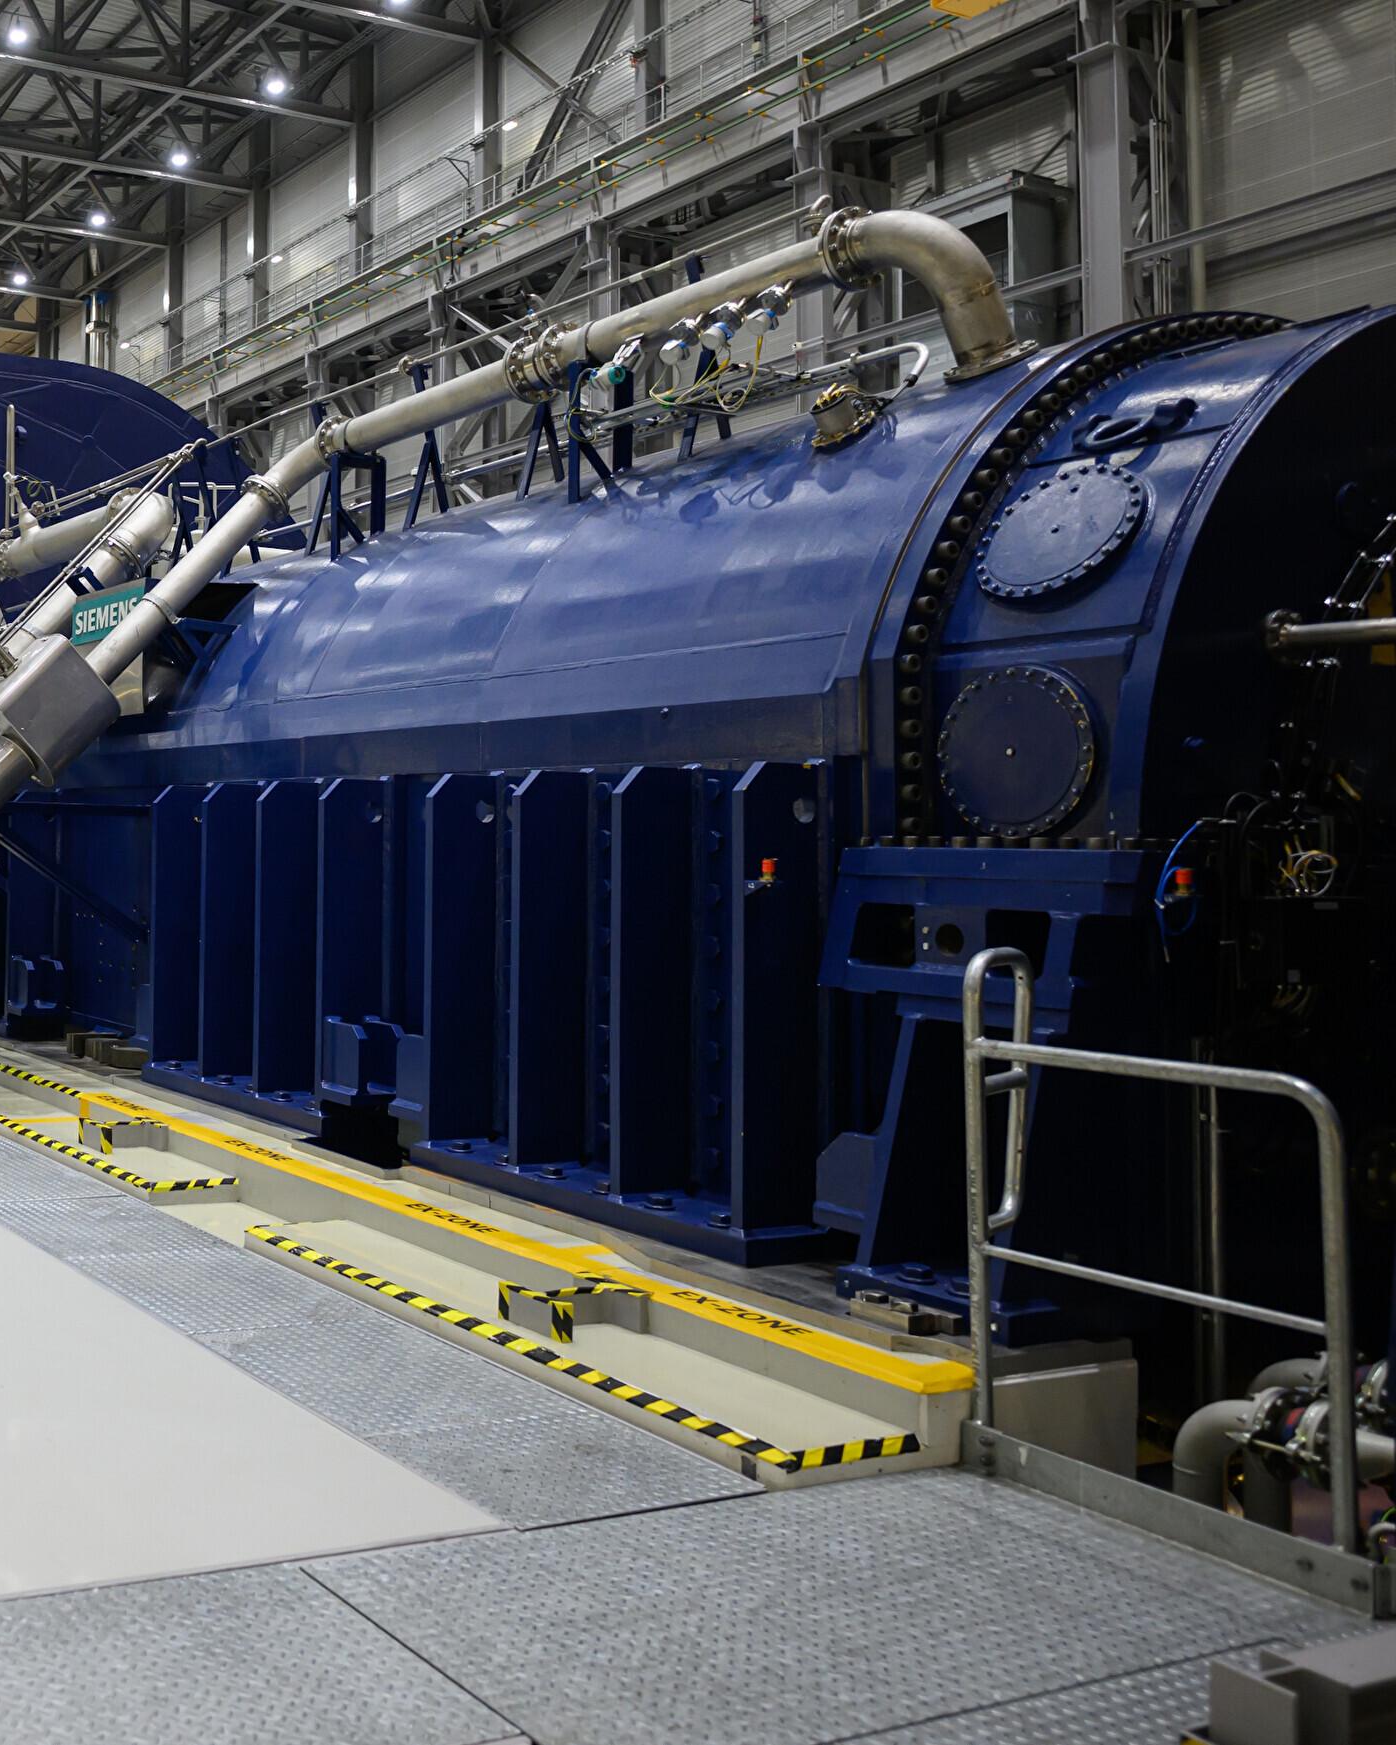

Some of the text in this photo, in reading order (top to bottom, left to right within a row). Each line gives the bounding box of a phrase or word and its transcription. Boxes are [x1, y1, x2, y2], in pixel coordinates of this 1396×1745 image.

[75, 597, 137, 635] SIEMENS
[224, 1138, 293, 1162] EX-ZONE
[404, 1203, 501, 1233] EX-ZONE
[669, 1290, 813, 1336] EX-ZONE
